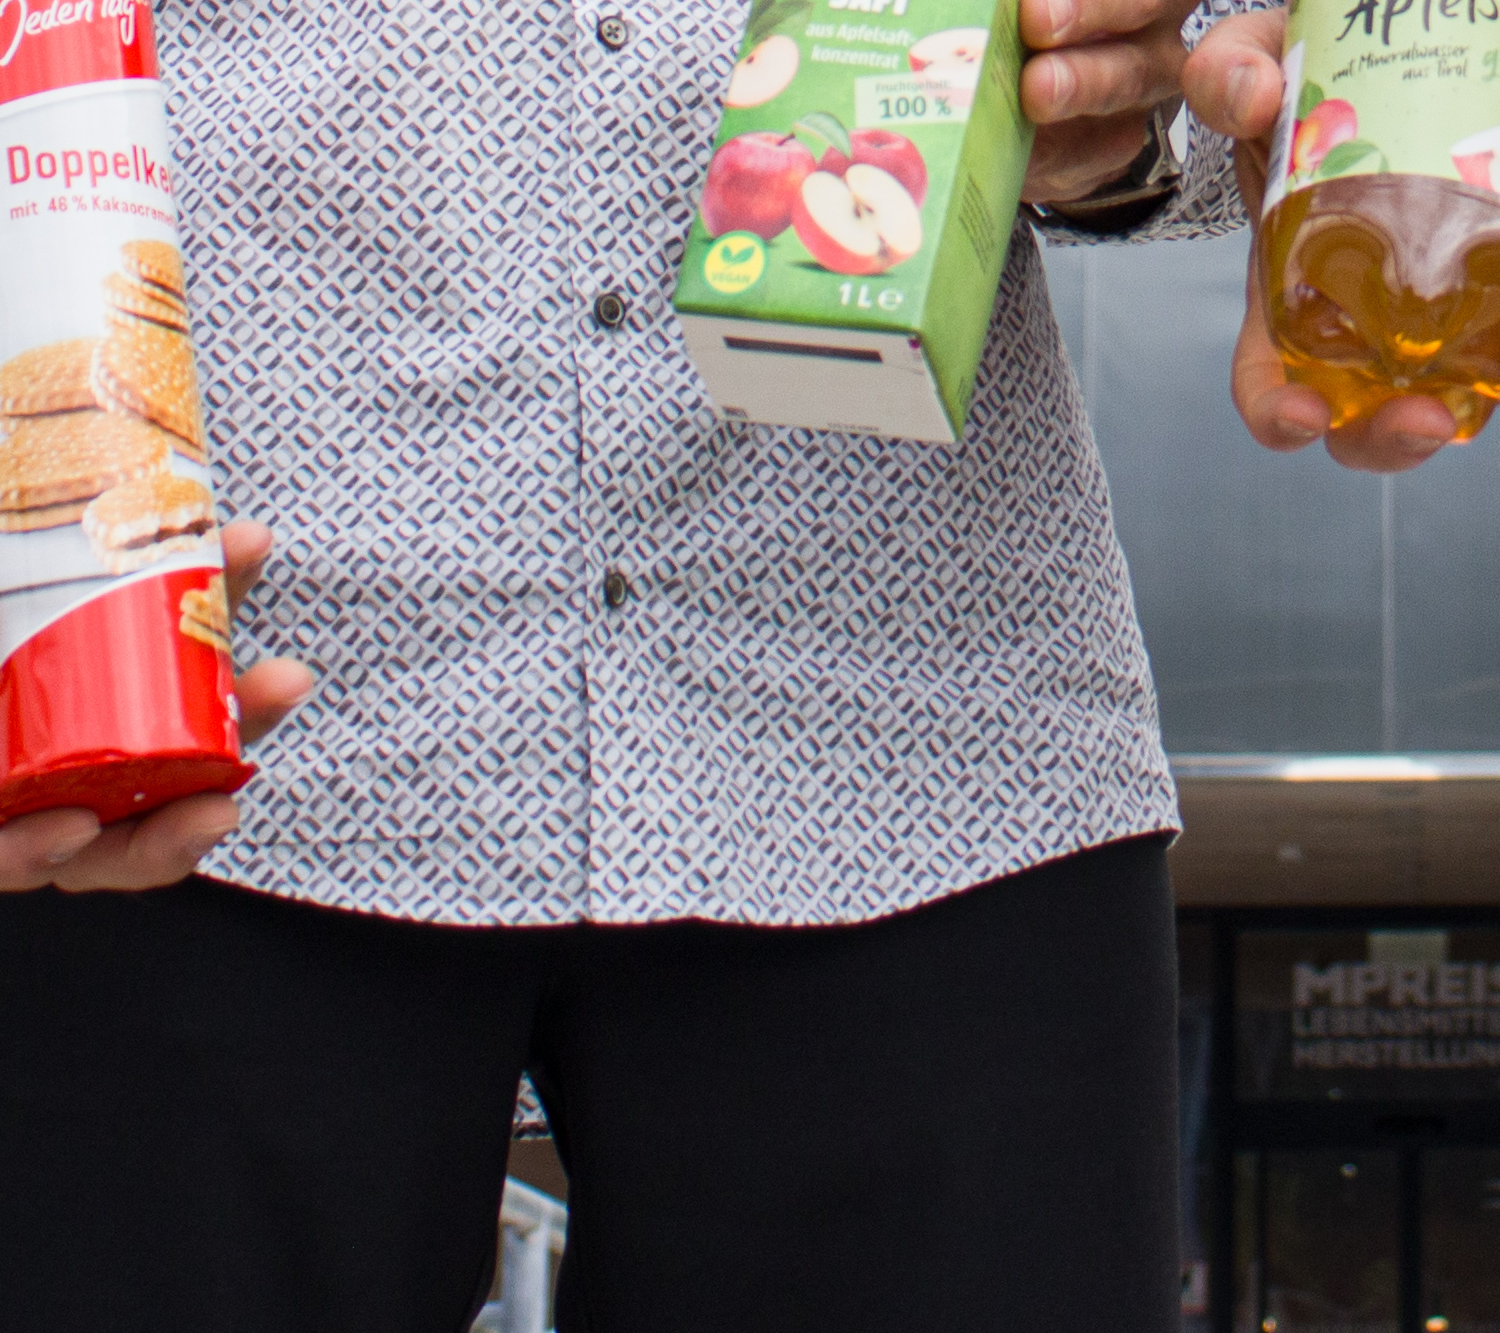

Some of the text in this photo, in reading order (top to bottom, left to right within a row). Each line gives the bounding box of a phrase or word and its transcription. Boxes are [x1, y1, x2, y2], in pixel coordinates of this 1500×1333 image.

[804, 23, 835, 39] aus
[811, 44, 901, 70] konzentrat
[1357, 41, 1469, 73] Mineralwasser
[1402, 57, 1468, 80] aus Tirol
[879, 95, 953, 119] 100 %
[10, 201, 38, 220] mit
[71, 195, 88, 212] %
[710, 271, 751, 284] VEGAN
